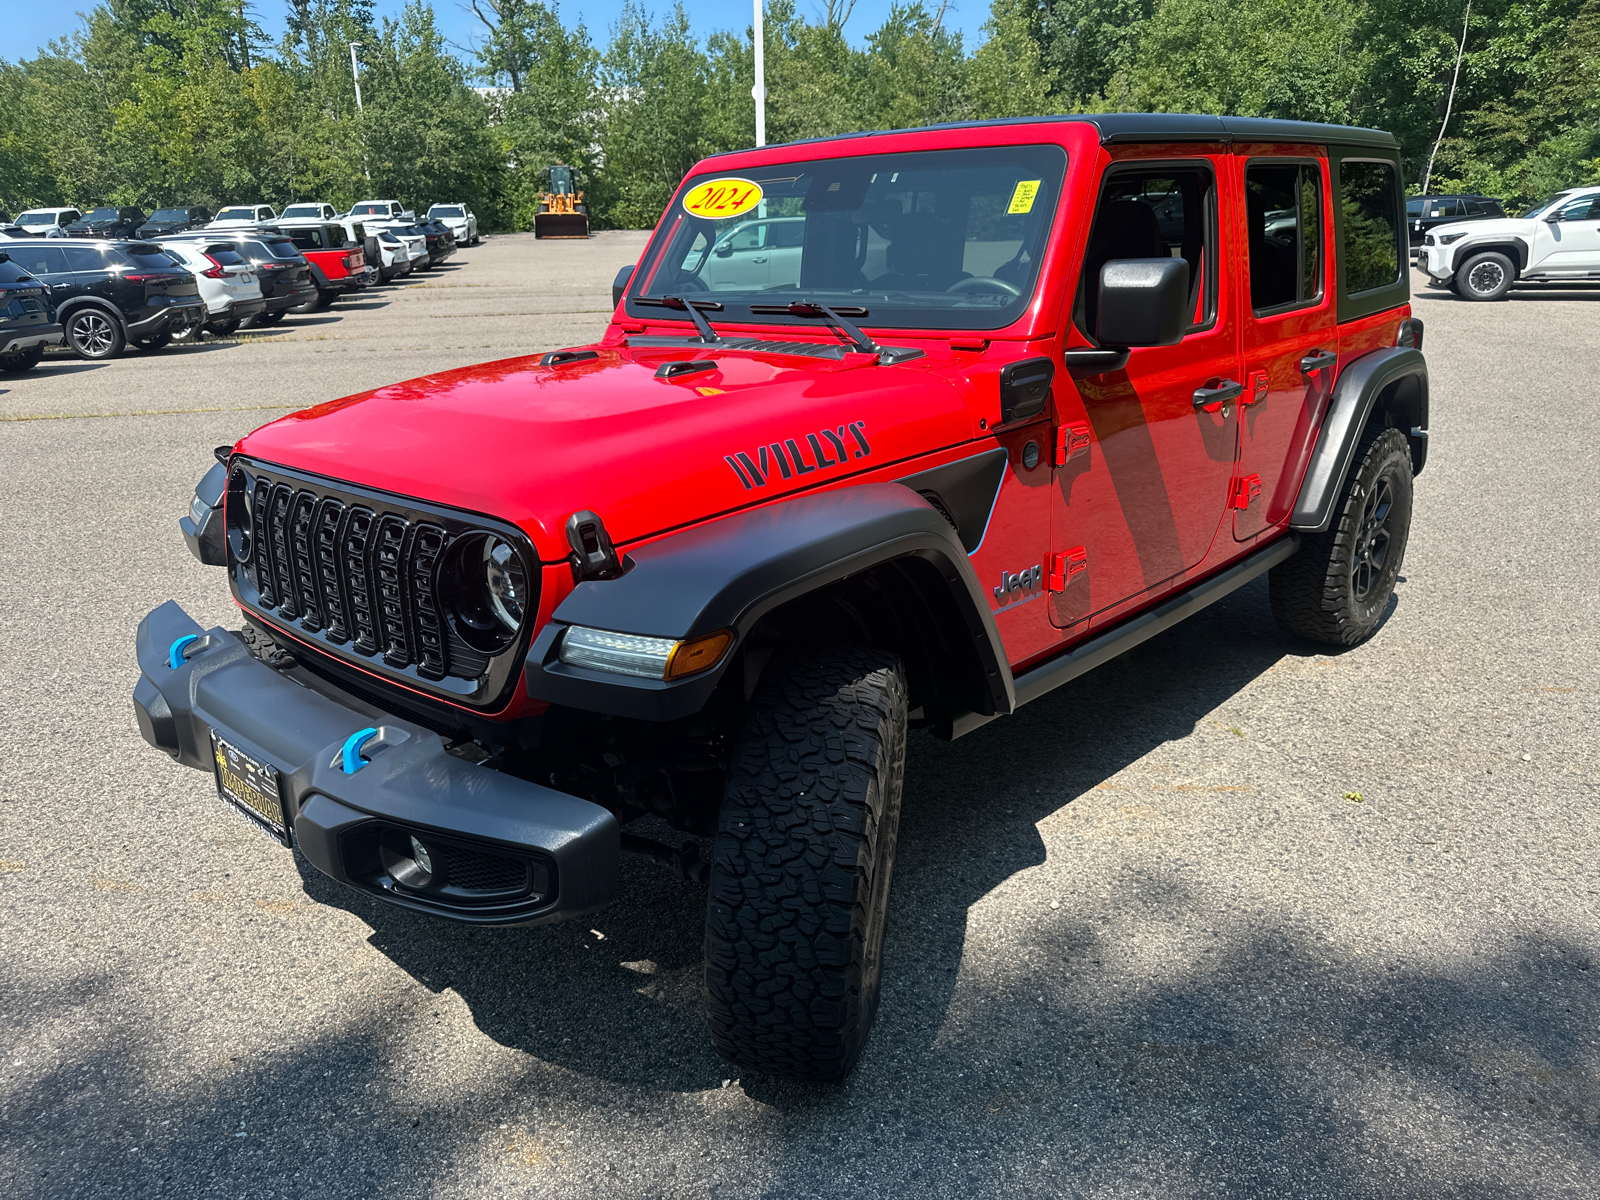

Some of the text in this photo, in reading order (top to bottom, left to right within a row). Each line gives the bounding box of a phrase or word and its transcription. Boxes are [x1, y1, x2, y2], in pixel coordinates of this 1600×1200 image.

[690, 187, 755, 210] 2024
[723, 420, 871, 490] WILLYS
[993, 564, 1043, 599] Jeep
